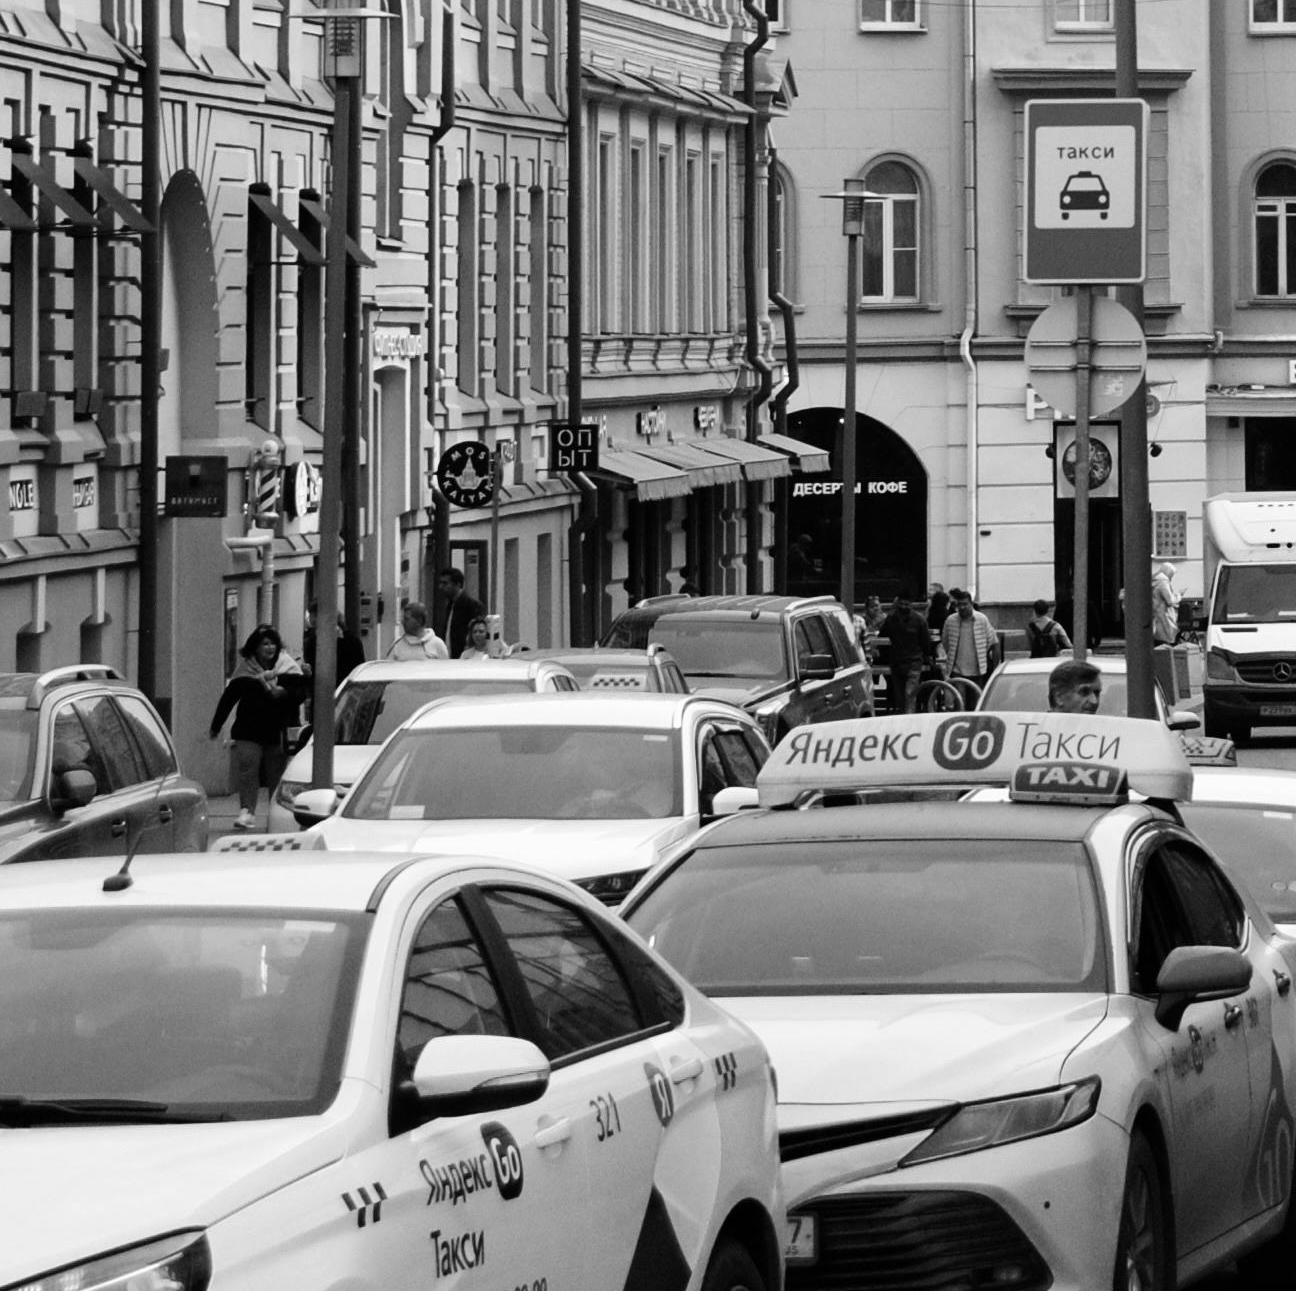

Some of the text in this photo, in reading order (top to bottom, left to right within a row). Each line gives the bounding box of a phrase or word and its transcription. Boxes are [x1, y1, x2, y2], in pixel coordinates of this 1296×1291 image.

[1056, 146, 1115, 159] такси
[450, 446, 487, 462] MOS
[868, 481, 908, 494] КОФЕ
[785, 721, 1121, 768] Яндекс Go Такси
[1025, 766, 1110, 788] TAXI
[589, 1092, 622, 1142] 321
[653, 1071, 672, 1119] Я
[419, 1136, 521, 1206] Яндекс Go
[430, 1229, 486, 1279] Такси
